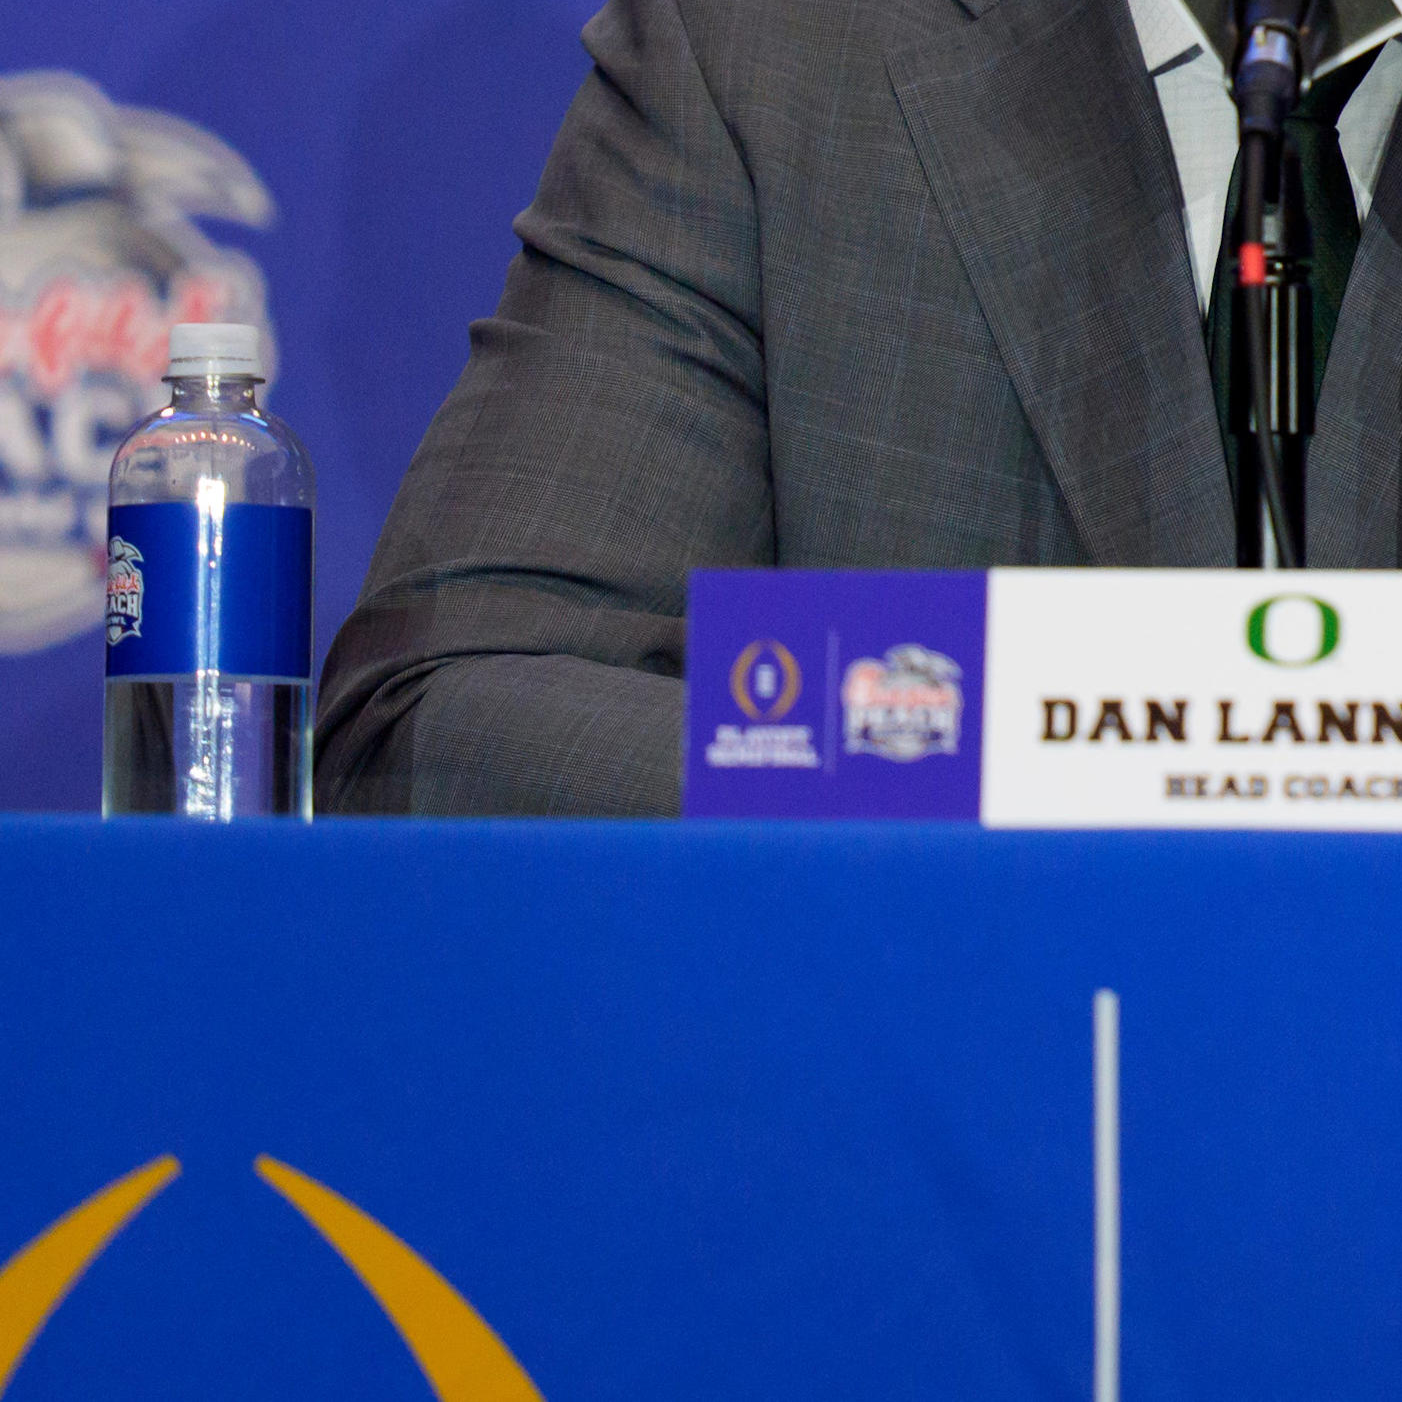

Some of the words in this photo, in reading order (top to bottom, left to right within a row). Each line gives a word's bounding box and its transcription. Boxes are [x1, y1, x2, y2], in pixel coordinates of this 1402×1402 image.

[107, 592, 138, 618] ACH
[1246, 592, 1341, 668] O
[1040, 698, 1188, 742] DAN
[1165, 773, 1270, 800] HEAD
